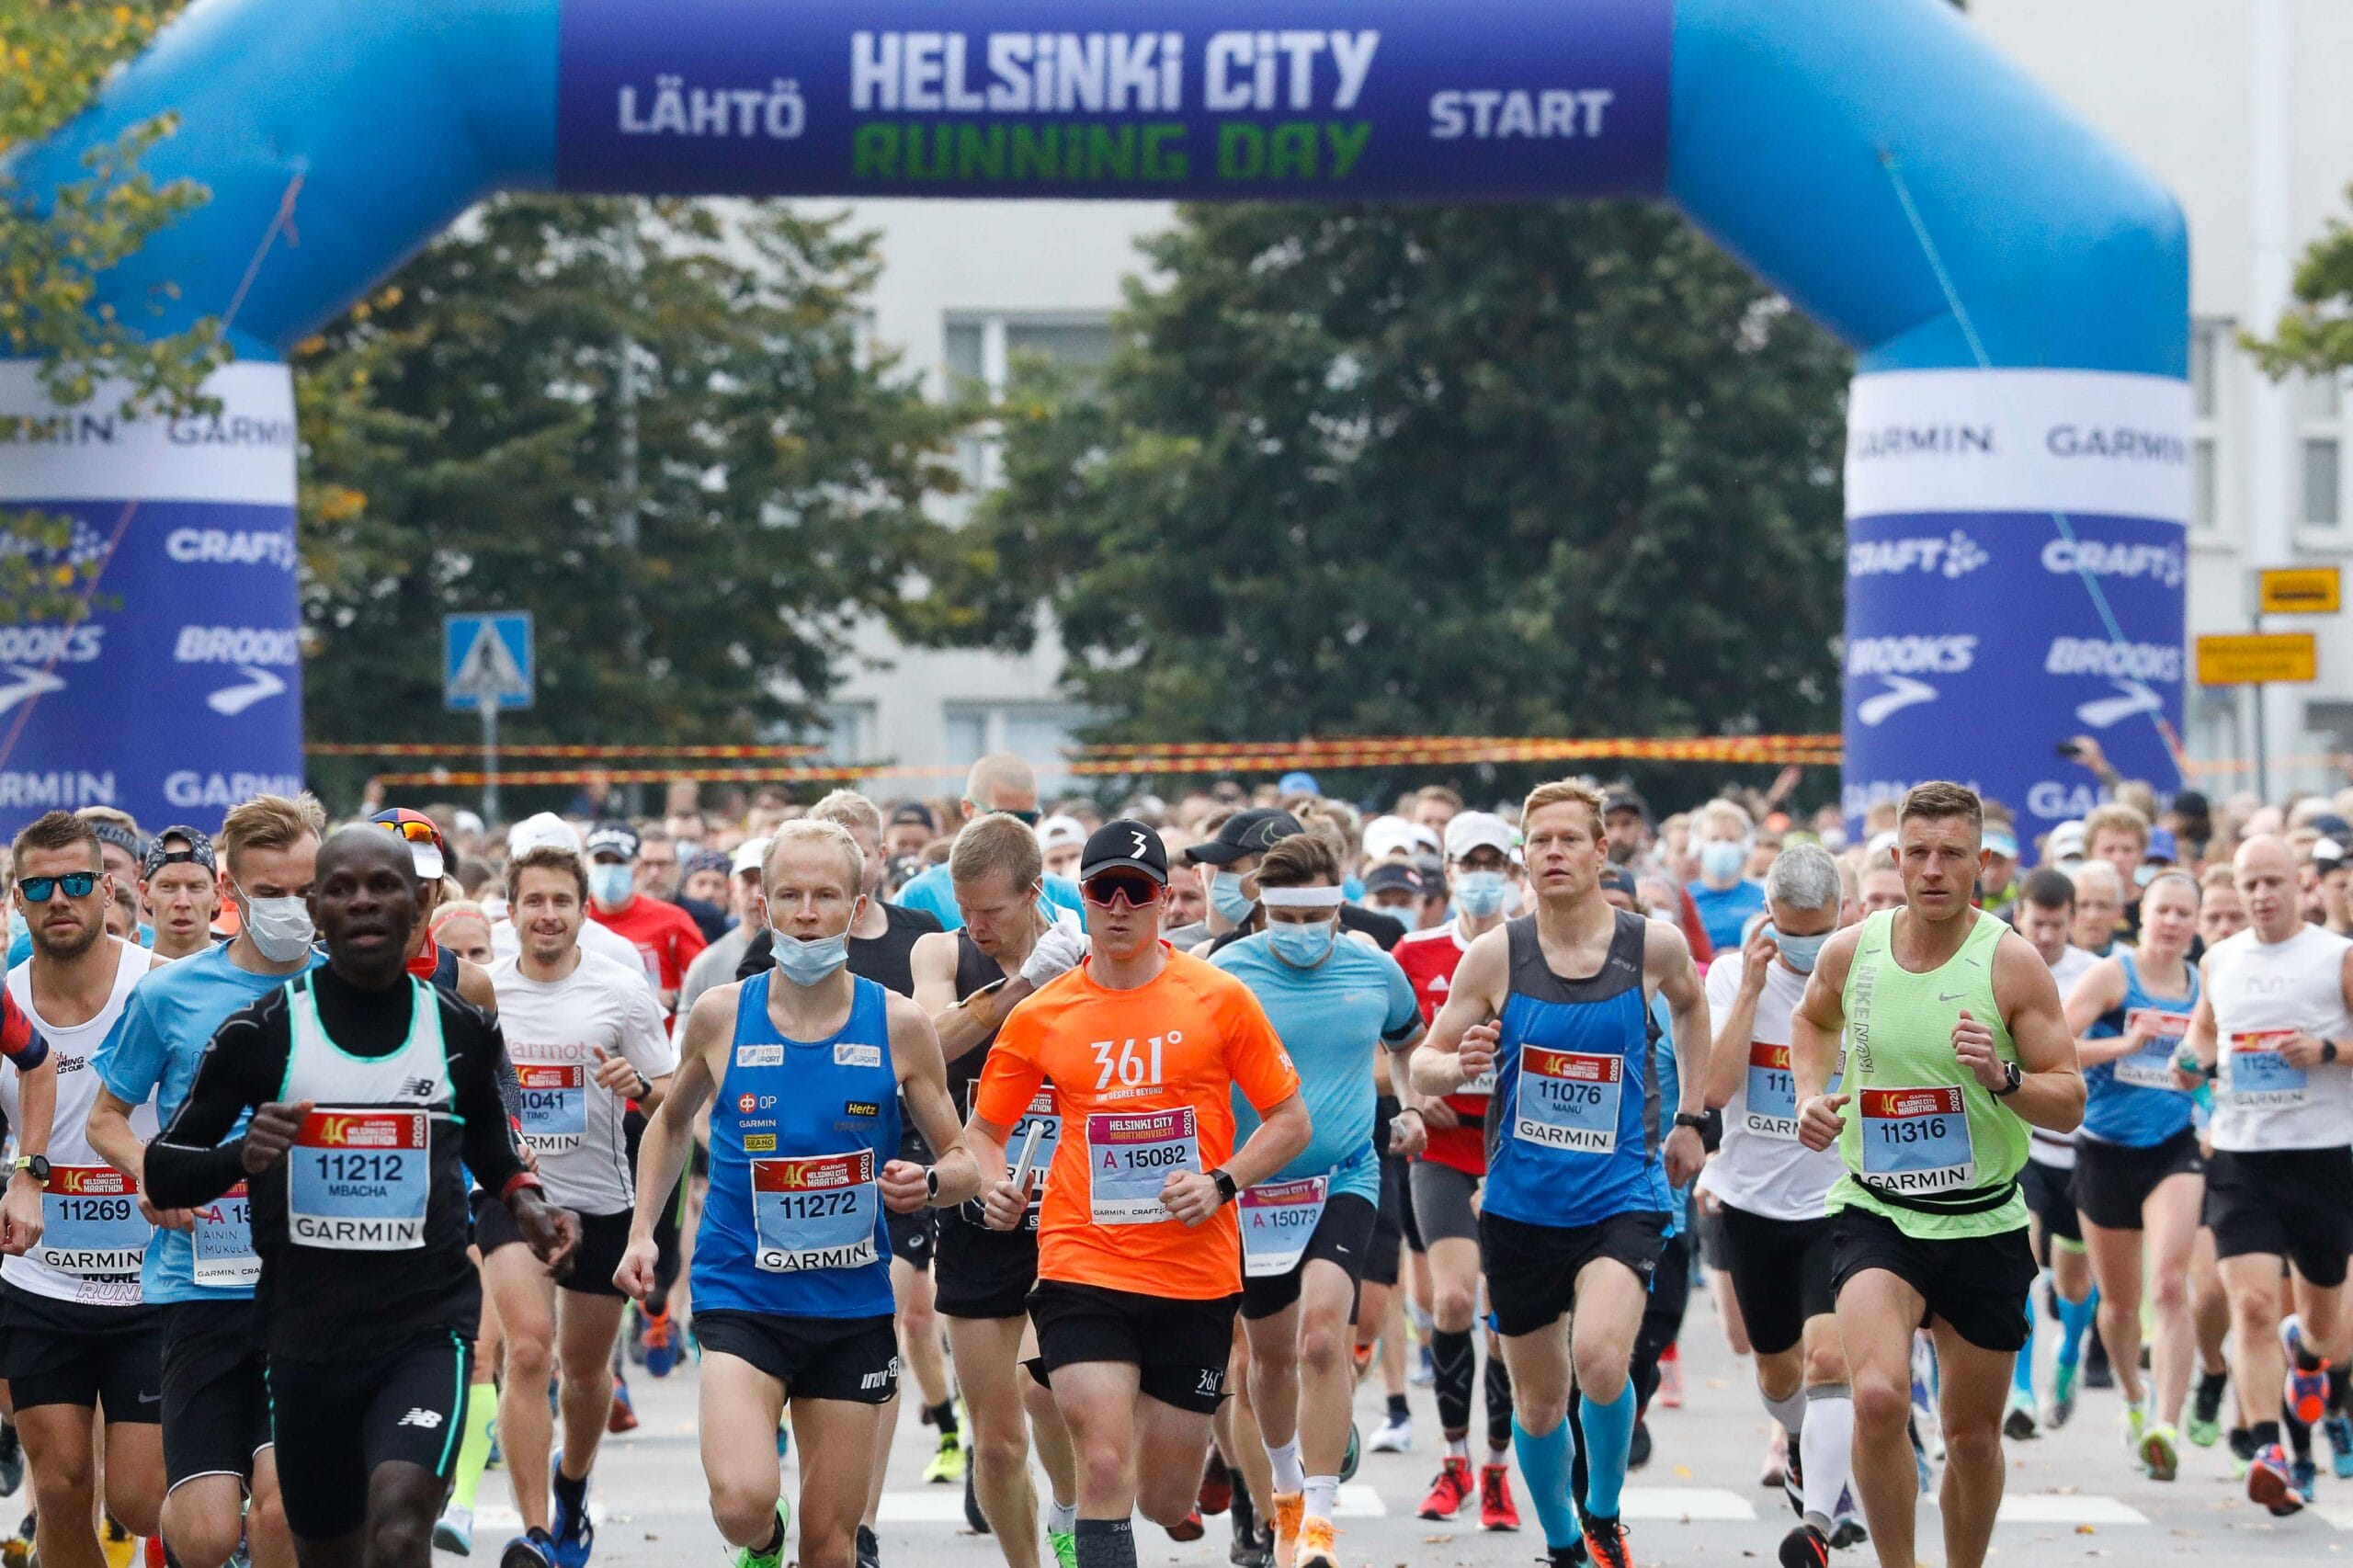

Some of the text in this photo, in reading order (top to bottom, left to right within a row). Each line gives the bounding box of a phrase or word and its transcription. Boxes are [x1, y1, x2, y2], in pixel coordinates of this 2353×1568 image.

[619, 74, 806, 139] LÄHTÖ
[1428, 90, 1615, 139] START
[1217, 119, 1372, 179] DAY
[1860, 425, 1993, 456] ARMIN
[1131, 830, 1147, 859] 3
[506, 1038, 586, 1060] armot
[1609, 1058, 1620, 1082] 2020
[520, 1092, 563, 1110] 1041
[759, 1096, 778, 1109] OP
[1108, 1089, 1135, 1100] DEGREE
[1539, 1079, 1601, 1105] 11076
[1949, 1089, 1961, 1112] 2020
[526, 1111, 549, 1119] TIMO
[847, 1103, 877, 1115] Hertz
[1552, 1102, 1582, 1115] MANU
[1897, 1104, 1938, 1116] MARATHON
[739, 1119, 777, 1128] GARMIN
[1183, 1110, 1193, 1136] 2020
[1881, 1117, 1947, 1144] 11316
[526, 1135, 579, 1150] RMIN
[745, 1138, 774, 1147] GRANO
[1519, 1120, 1608, 1148] GARMIN
[820, 1163, 847, 1171] GARMIN
[859, 1153, 870, 1181] 2020
[1103, 1144, 1188, 1169] A 15082
[316, 1153, 403, 1182] 11212
[1867, 1166, 1965, 1190] GARMIN
[83, 1184, 124, 1193] MARATHON
[328, 1185, 388, 1198] MBACHA
[806, 1176, 849, 1187] MARATHON
[59, 1199, 131, 1221] 11269
[208, 1204, 225, 1225] A
[779, 1190, 858, 1220] 11272
[1131, 1207, 1159, 1215] CRAFT
[1253, 1209, 1317, 1228] A 15073
[296, 1217, 415, 1242] GARMIN
[44, 1250, 143, 1268] GARMIN
[763, 1242, 870, 1270] GARMIN
[82, 1273, 141, 1284] WORL
[197, 1269, 235, 1278] GARMIN
